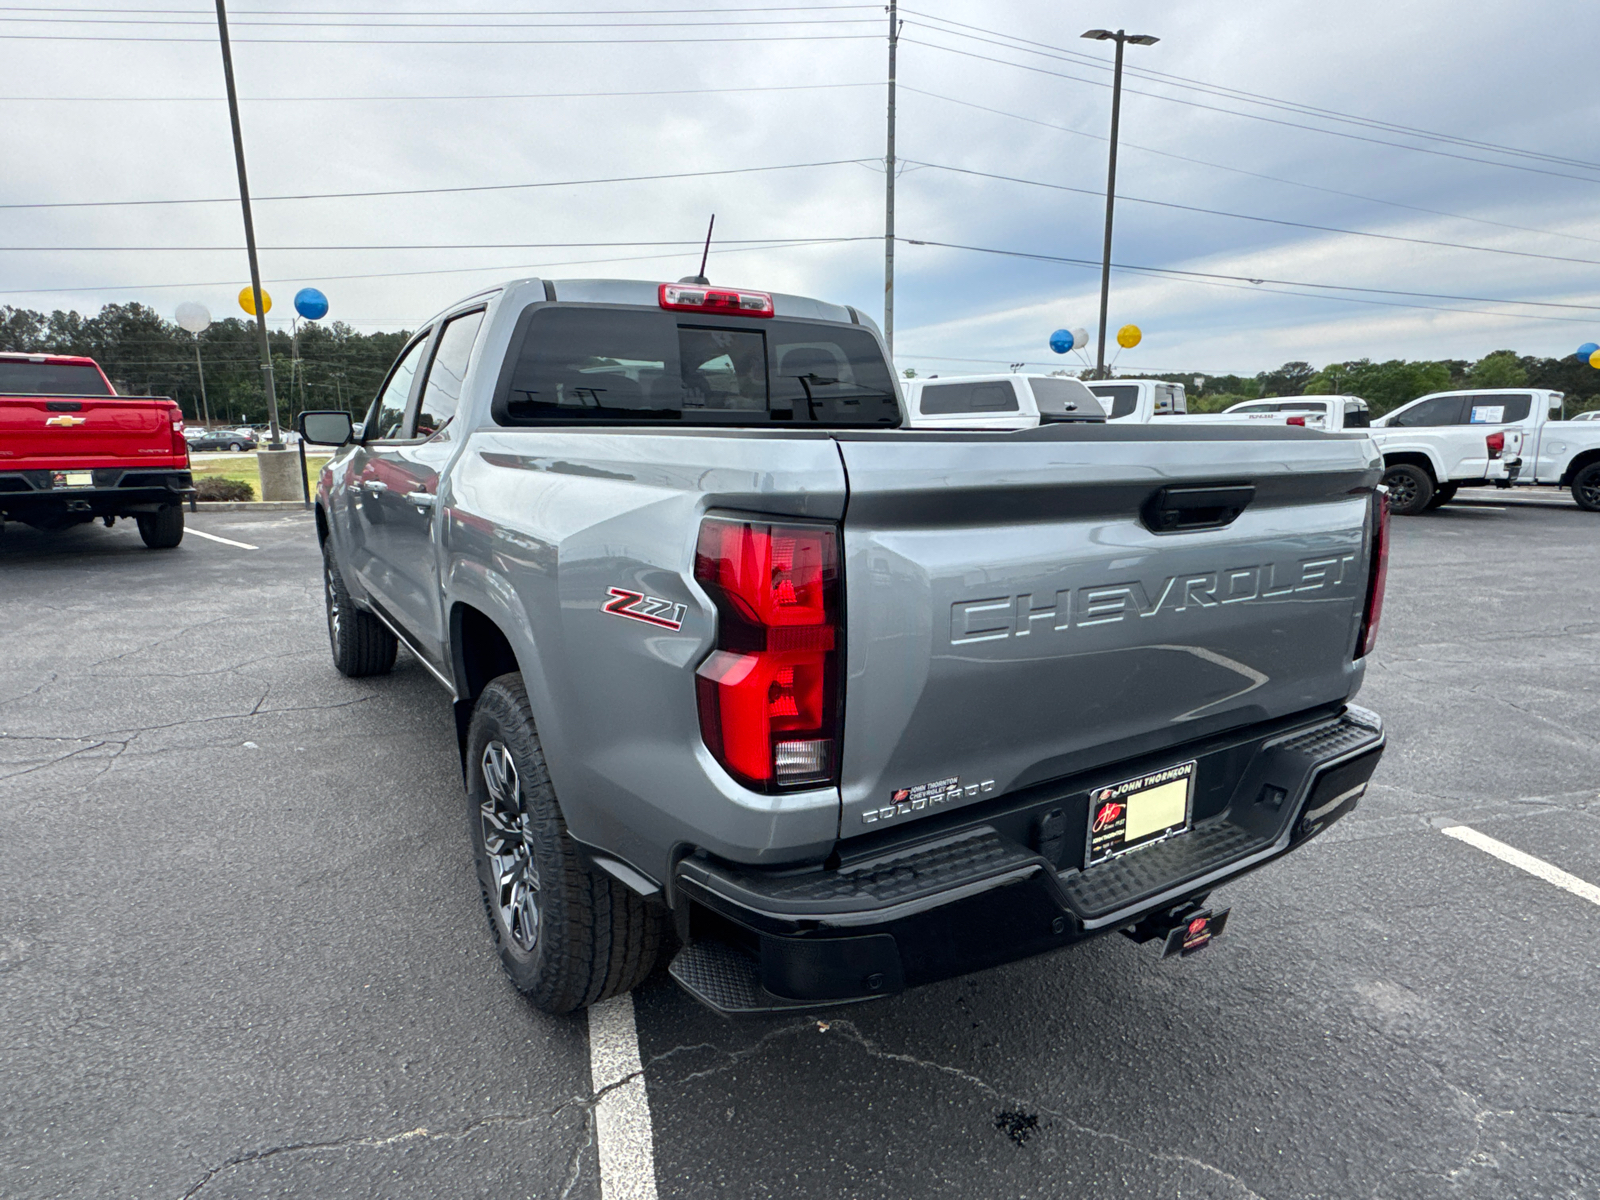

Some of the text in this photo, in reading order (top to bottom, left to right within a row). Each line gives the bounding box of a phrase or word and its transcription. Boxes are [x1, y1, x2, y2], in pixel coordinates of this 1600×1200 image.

[601, 586, 688, 632] Z71
[949, 554, 1355, 645] CHEVROLET
[909, 787, 946, 800] CHEVROLET
[910, 777, 958, 794] JOHN THORNTON
[1117, 764, 1191, 795] JOHN THORNTON
[862, 780, 995, 823] COLORADO
